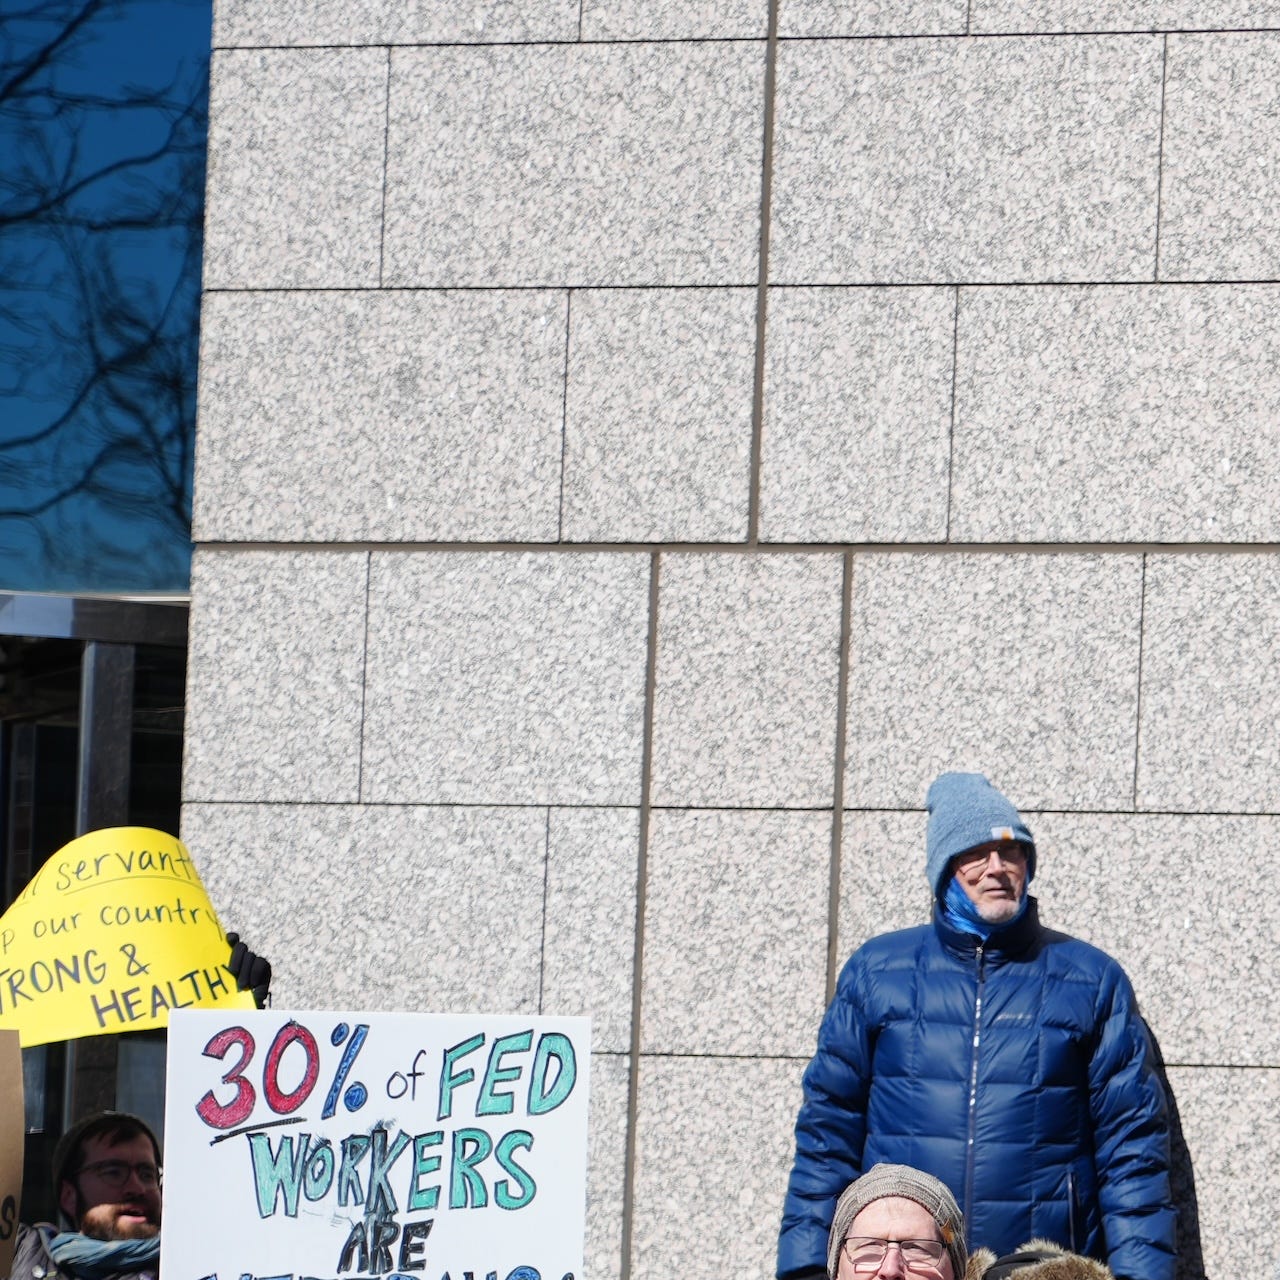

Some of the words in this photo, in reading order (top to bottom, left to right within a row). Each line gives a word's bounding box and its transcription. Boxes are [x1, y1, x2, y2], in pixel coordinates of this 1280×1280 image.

[34, 910, 81, 939] our
[100, 898, 223, 941] country
[120, 943, 151, 976] &
[196, 1020, 370, 1130] 30%
[387, 1049, 426, 1100] of
[437, 1029, 577, 1121] FED
[247, 1127, 537, 1220] WORKERS
[336, 1216, 434, 1274] ARE
